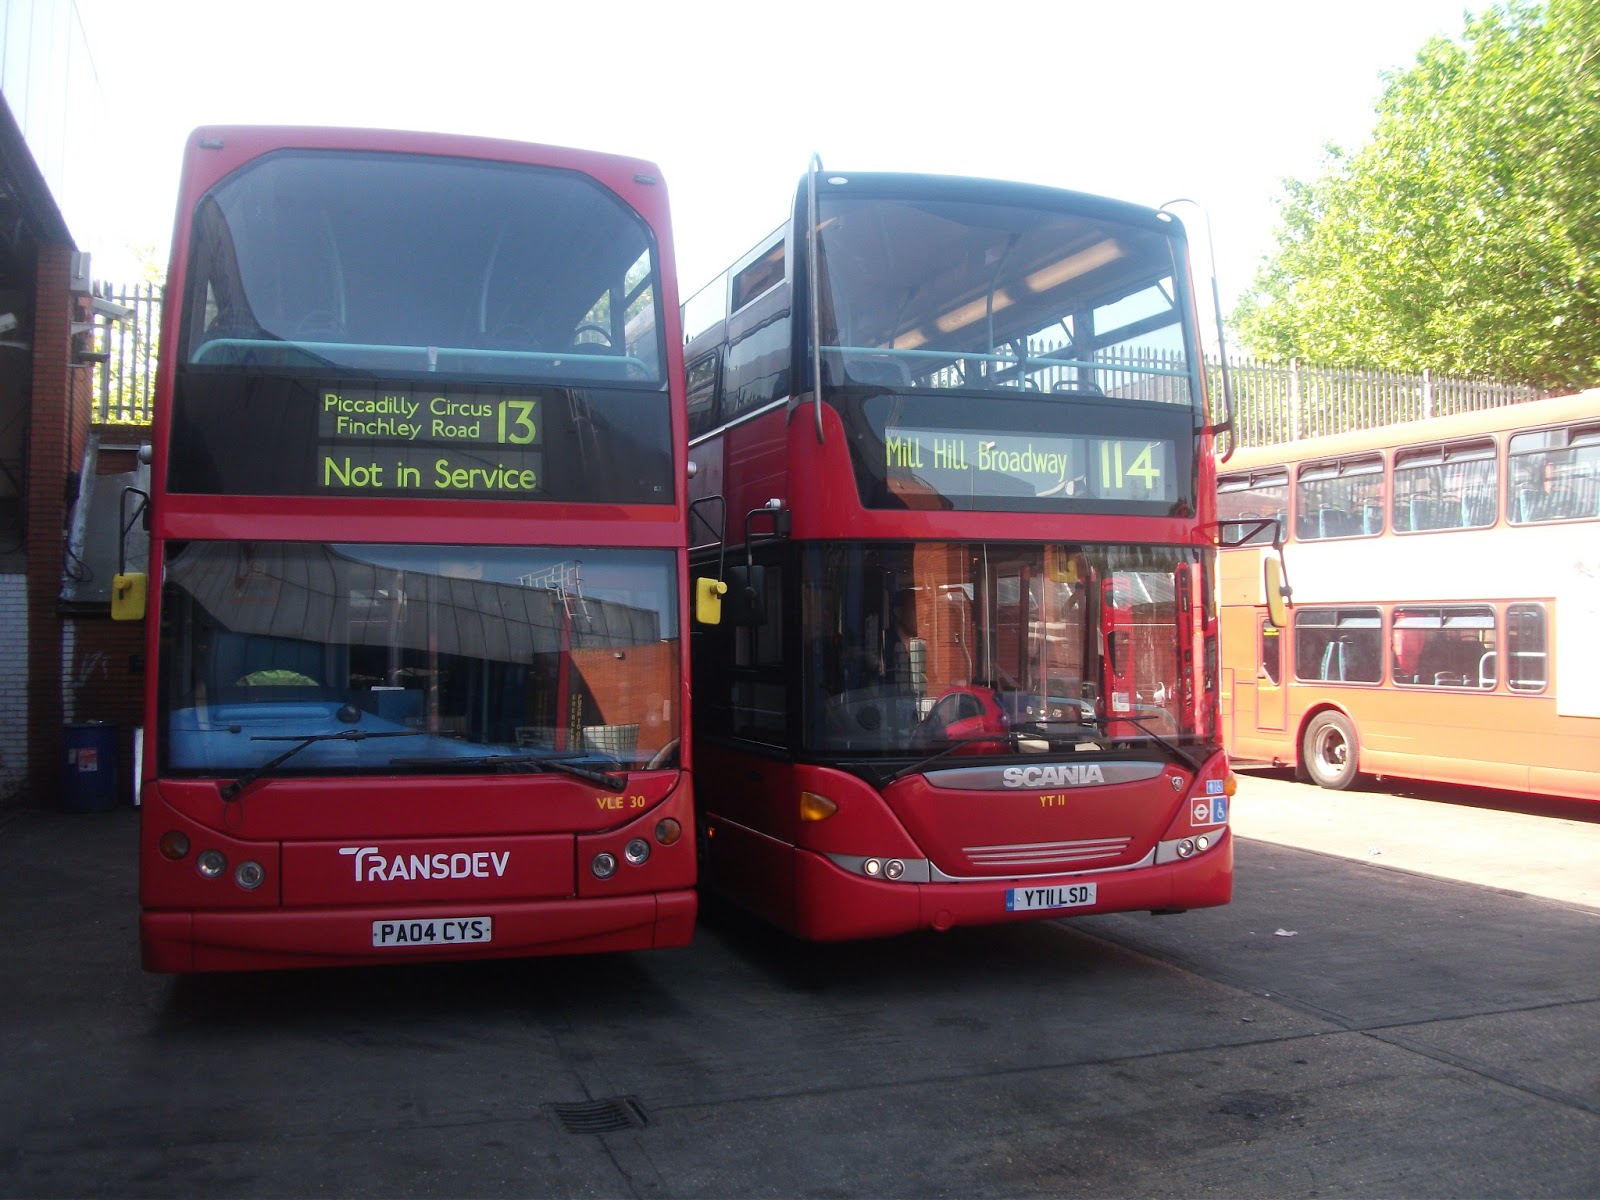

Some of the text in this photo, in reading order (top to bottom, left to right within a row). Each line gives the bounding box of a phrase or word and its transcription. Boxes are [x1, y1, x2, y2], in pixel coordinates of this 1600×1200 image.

[324, 393, 493, 419] Piccadilly Circus
[337, 416, 480, 441] Finchley Road
[497, 400, 537, 445] 13
[886, 436, 1068, 481] Mill Hill Broadway
[1101, 440, 1160, 489] 114
[324, 456, 537, 489] Not in Service
[1003, 764, 1105, 788] SCANIA
[596, 795, 646, 810] VLE 30
[1040, 795, 1055, 807] YT
[338, 846, 511, 882] TRANSDEV
[1024, 886, 1088, 907] YT11 LSD
[381, 920, 483, 943] PA04 CYS
